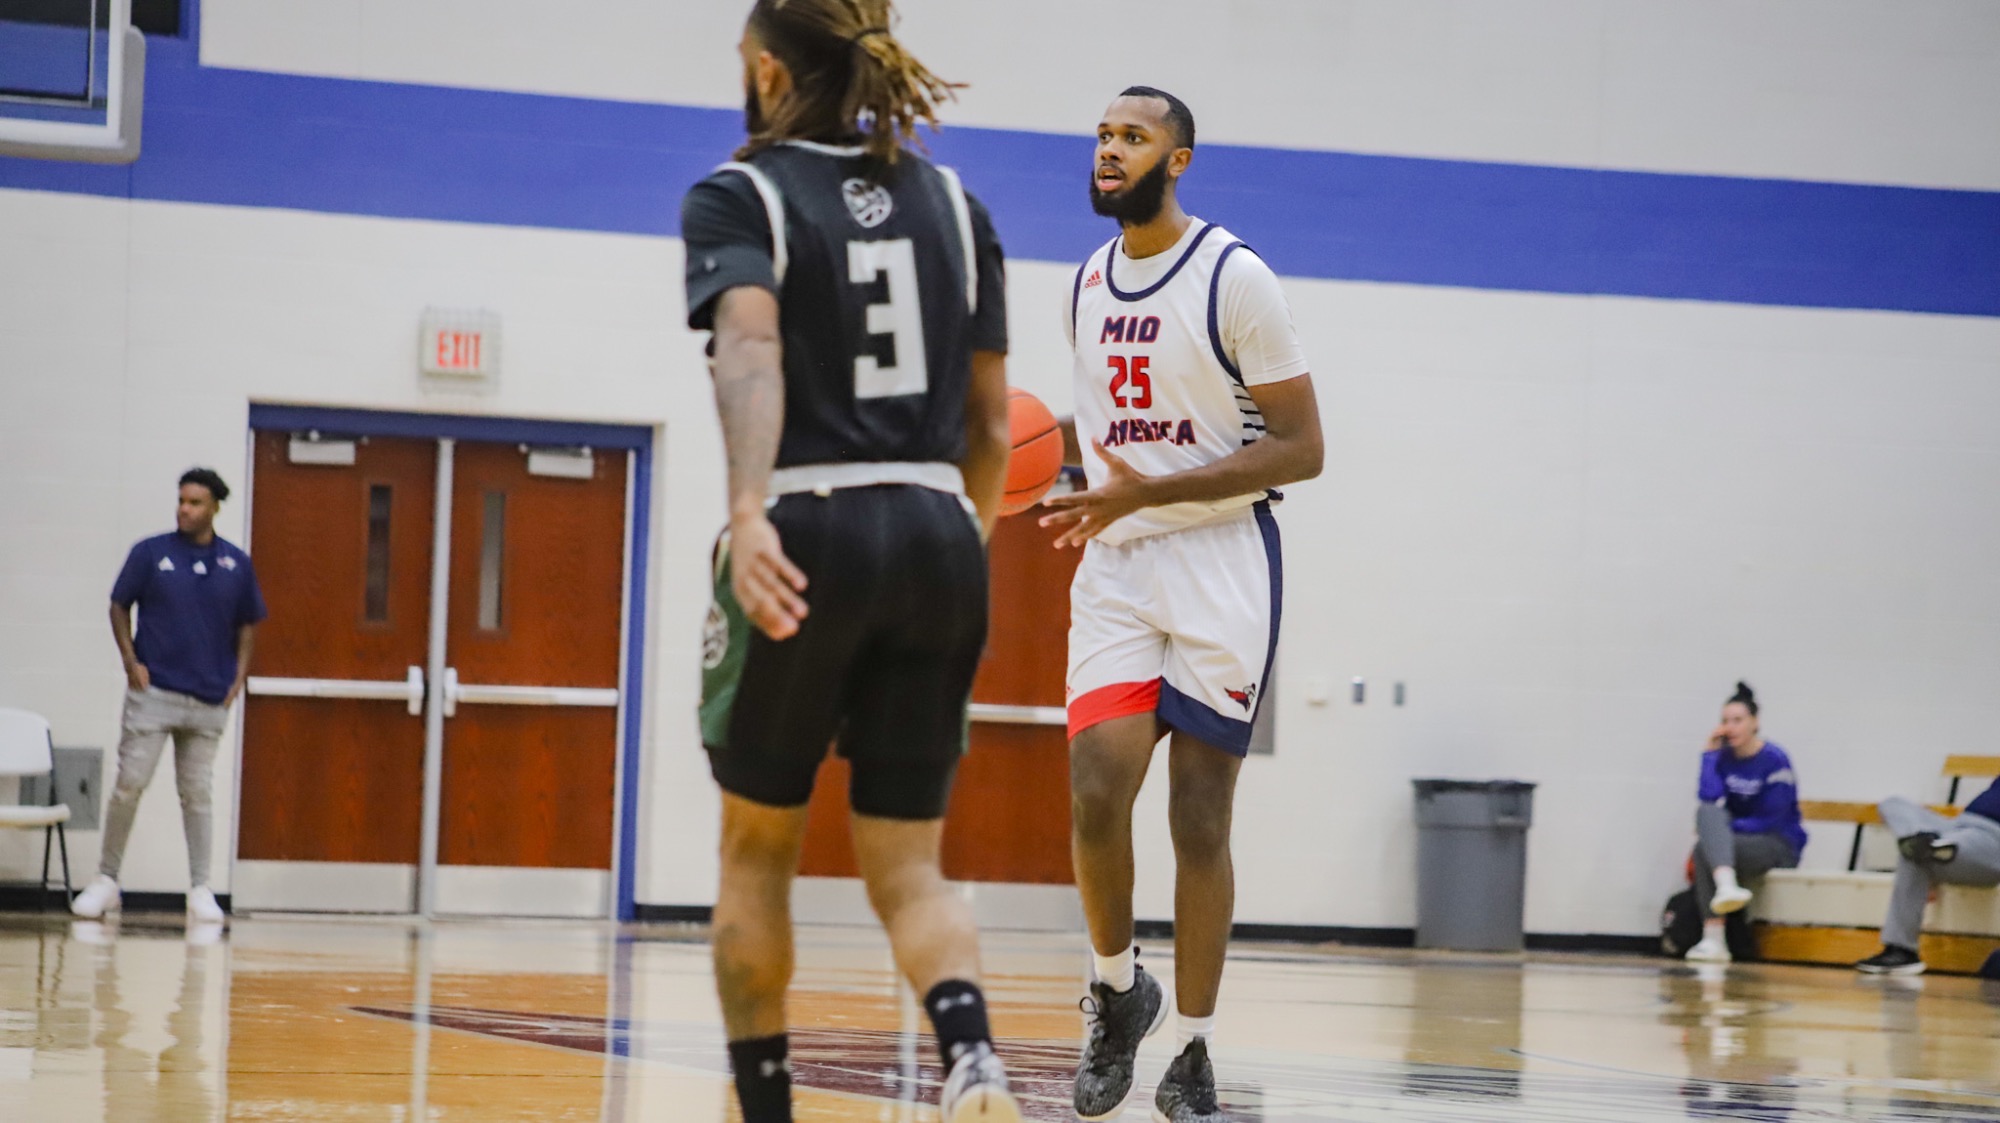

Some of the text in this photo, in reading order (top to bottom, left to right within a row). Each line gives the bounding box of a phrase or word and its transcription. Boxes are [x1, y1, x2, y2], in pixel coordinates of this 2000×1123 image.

[847, 238, 927, 399] 3
[1100, 315, 1161, 344] MID
[437, 331, 481, 368] EXIT
[1107, 355, 1153, 409] 25
